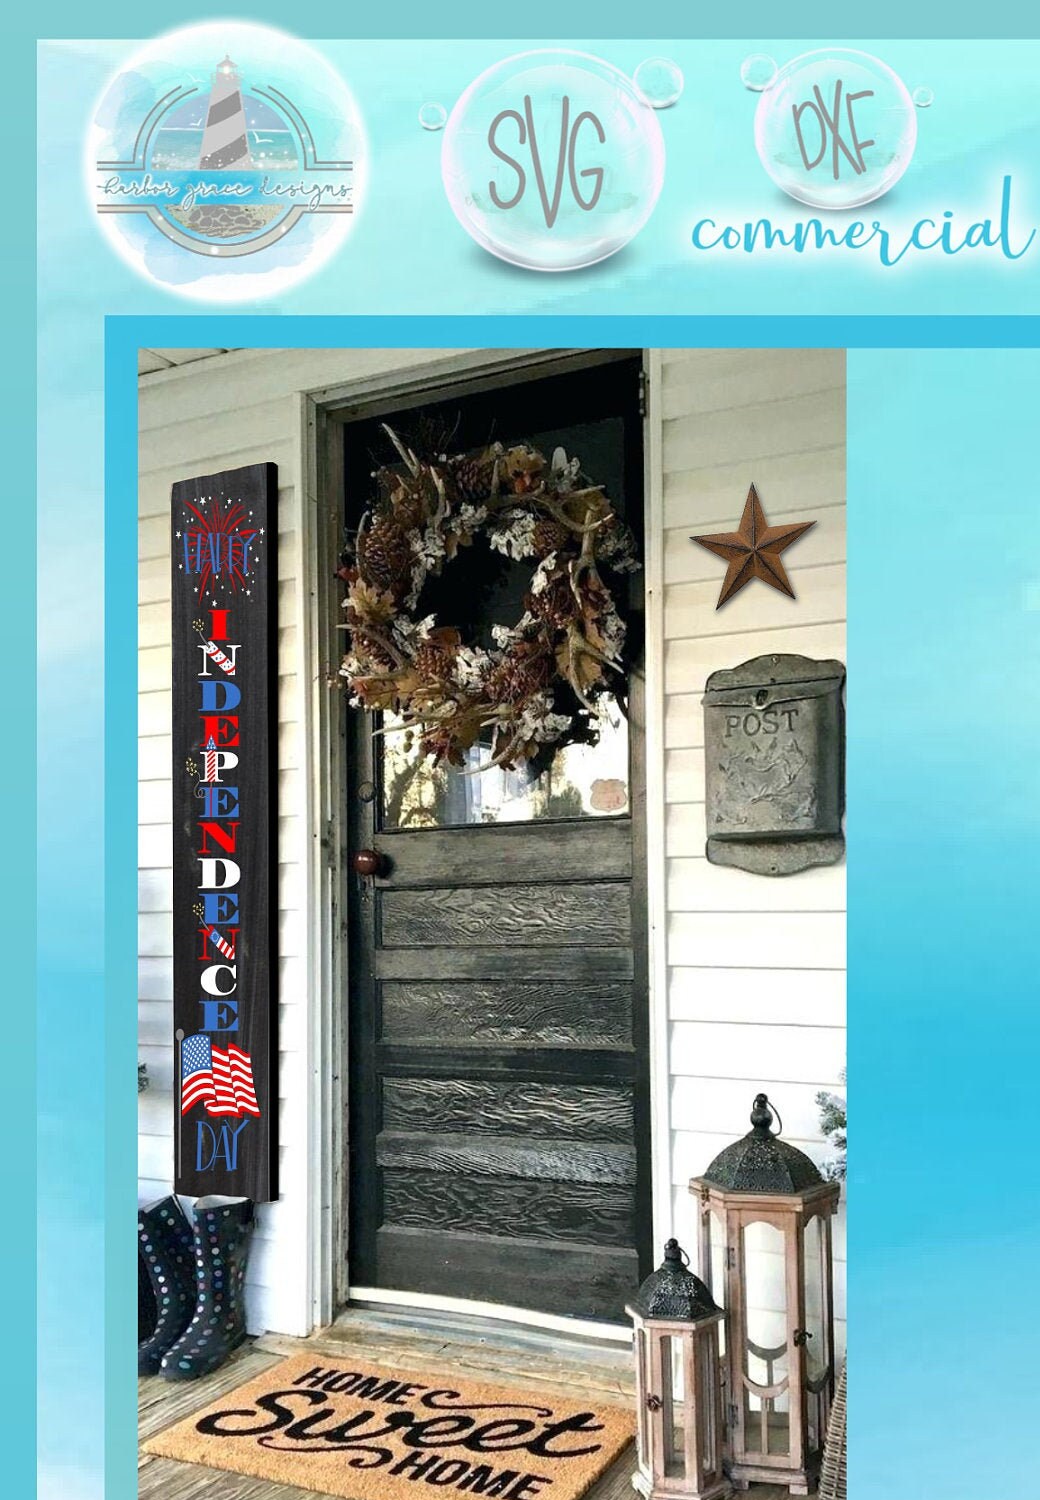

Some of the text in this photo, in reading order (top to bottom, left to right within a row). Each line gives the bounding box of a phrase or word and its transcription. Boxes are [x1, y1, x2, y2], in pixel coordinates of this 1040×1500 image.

[182, 532, 256, 575] HAPPY
[724, 709, 799, 738] POST
[197, 609, 242, 1032] INDEPENDENCE
[195, 1118, 250, 1172] DAY
[292, 1366, 424, 1407] HOME
[196, 1389, 606, 1460] Sweet
